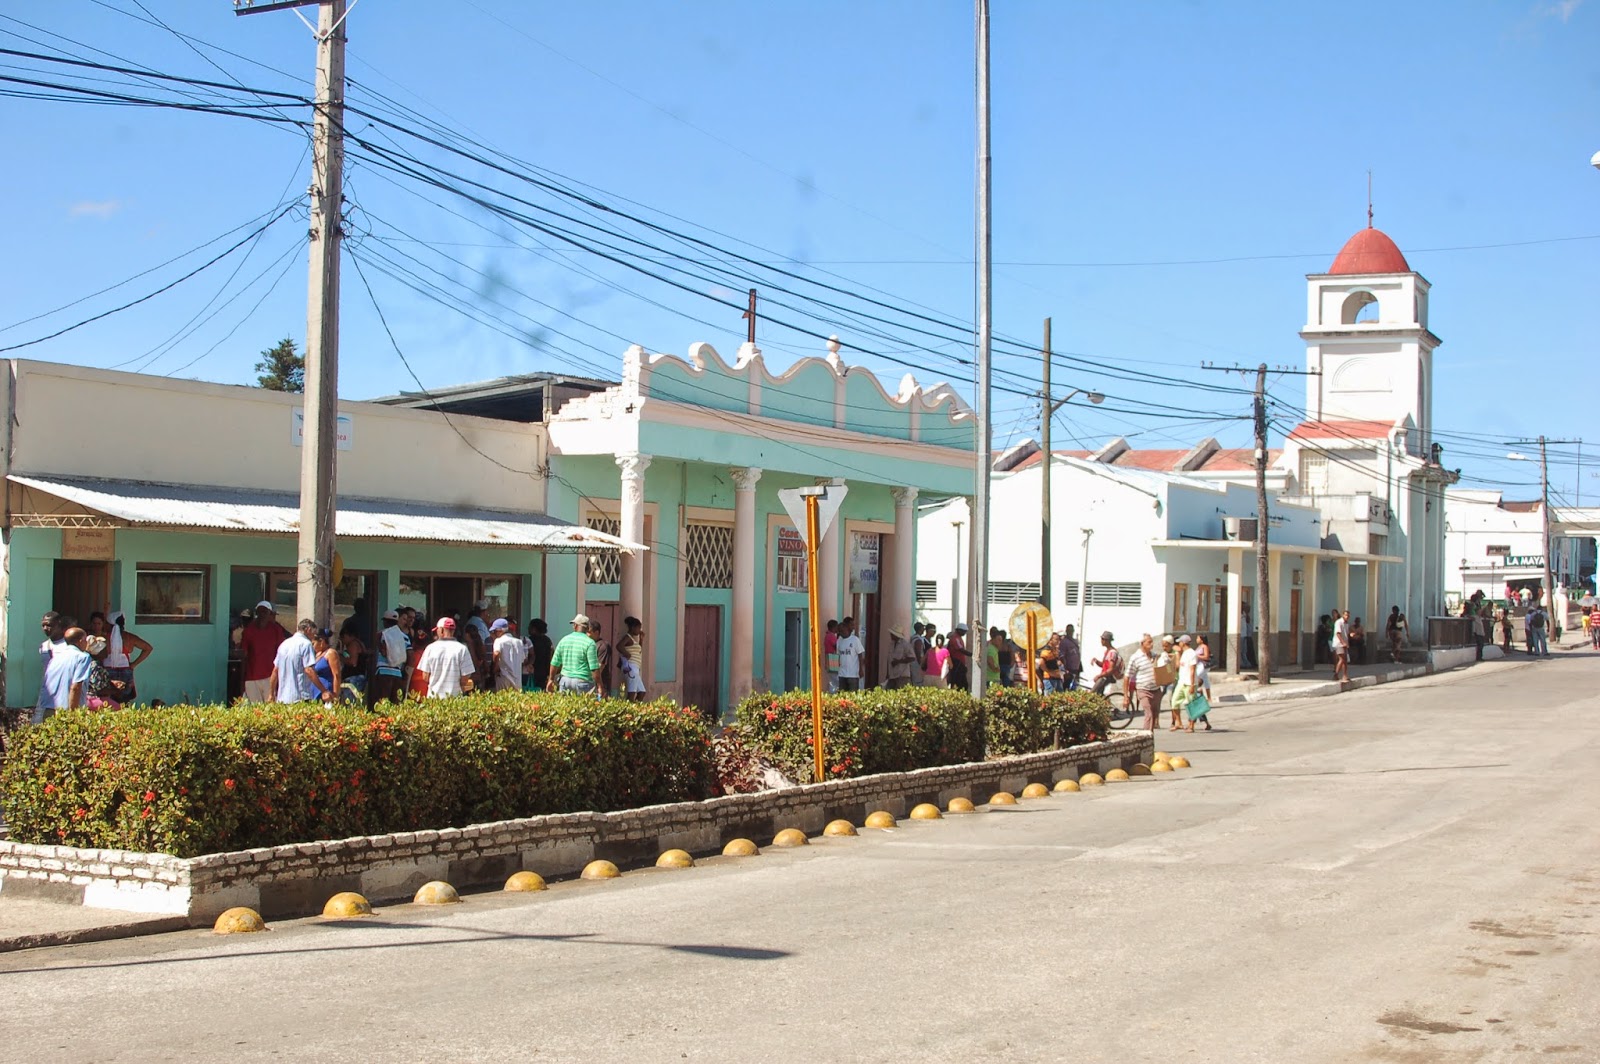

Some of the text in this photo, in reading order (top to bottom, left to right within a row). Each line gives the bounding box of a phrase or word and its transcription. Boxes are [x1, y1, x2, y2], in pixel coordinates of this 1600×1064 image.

[779, 527, 799, 538] Casa
[1506, 556, 1545, 566] LA MAYA
